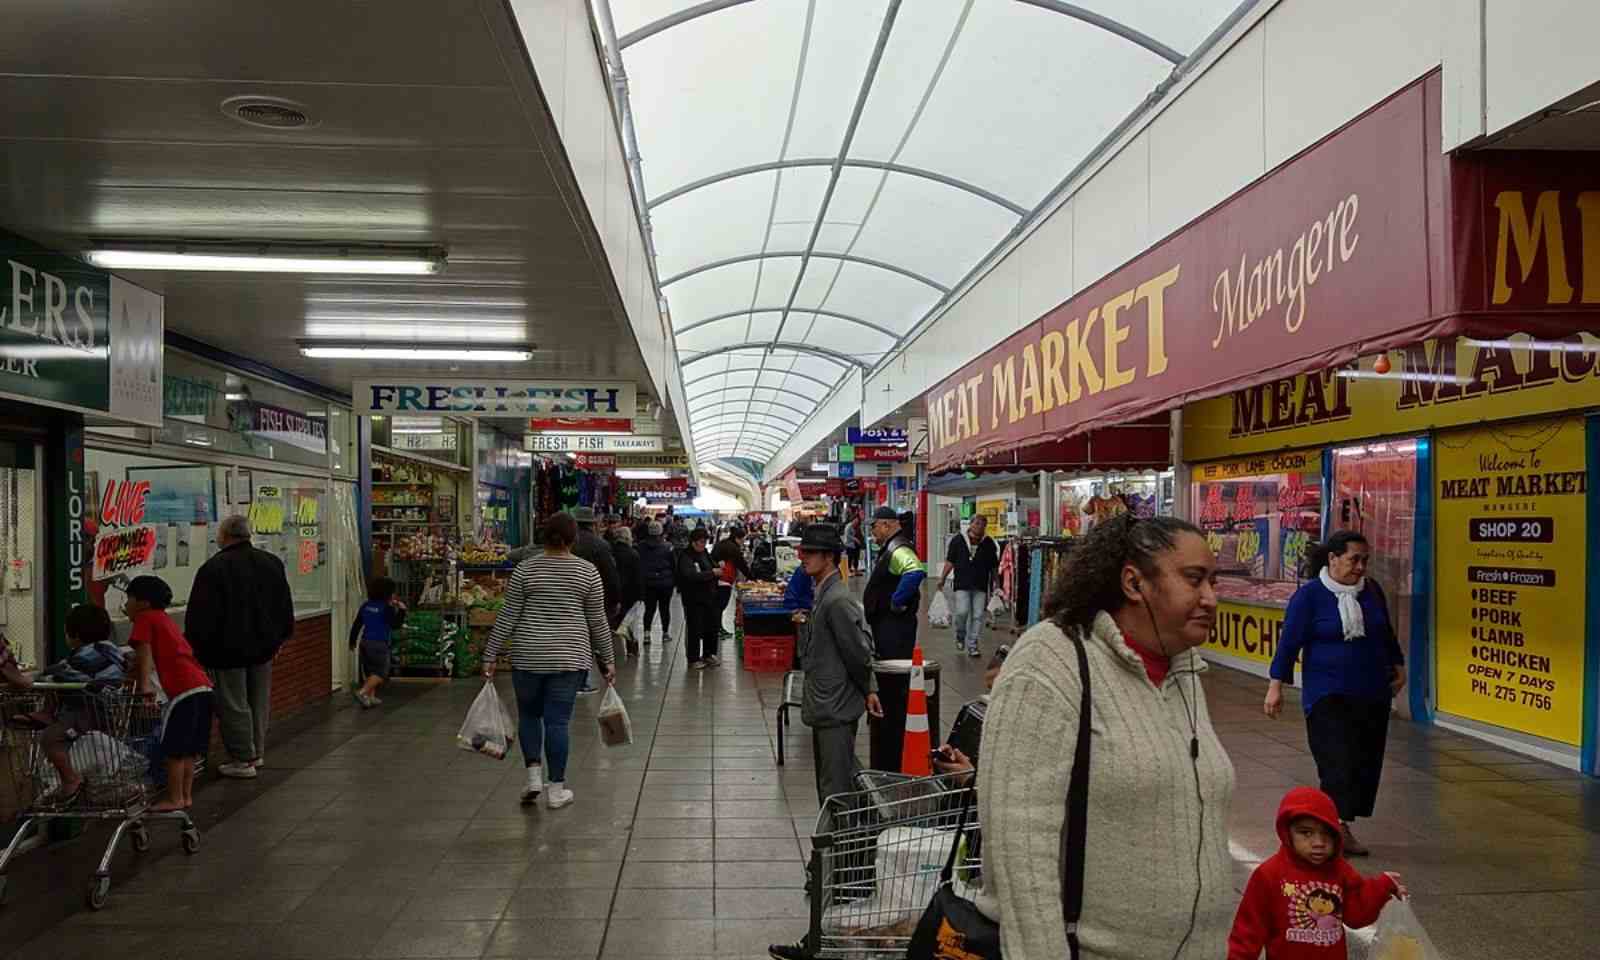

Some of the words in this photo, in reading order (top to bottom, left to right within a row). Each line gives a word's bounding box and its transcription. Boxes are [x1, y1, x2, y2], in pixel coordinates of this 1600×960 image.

[1212, 193, 1360, 349] Mangere
[0, 259, 95, 353] ERS
[0, 357, 39, 378] ER
[928, 373, 984, 451] MEAT
[991, 263, 1181, 429] MARKET
[370, 385, 511, 412] FRESH
[527, 386, 619, 413] FISH
[1229, 366, 1354, 439] MEAT
[260, 407, 284, 433] FISH
[532, 436, 569, 450] FRESH
[578, 437, 605, 450] FISH
[613, 440, 656, 449] TAKEAWAYS
[1271, 455, 1306, 470] CHICKEN
[1479, 453, 1525, 473] Welcome
[1529, 449, 1542, 469] To
[1440, 479, 1491, 500] MEAT
[1495, 470, 1586, 498] MARKET
[101, 479, 151, 529] LIVE
[68, 470, 83, 591] LORUS
[1479, 523, 1516, 538] SHOP
[1521, 522, 1541, 537] 20
[1476, 569, 1501, 582] Fresh
[1510, 570, 1544, 585] Frozen
[1480, 588, 1517, 606] BEEF
[1480, 607, 1522, 627] PORK
[1480, 627, 1524, 648] LAMB
[1480, 646, 1550, 673] CHICKEN
[1467, 664, 1502, 680] OPEN
[1507, 672, 1515, 682] 7
[1520, 675, 1556, 692] DAYS
[1472, 679, 1491, 697] PH.
[1495, 684, 1517, 703] 275
[1523, 690, 1552, 711] 7756
